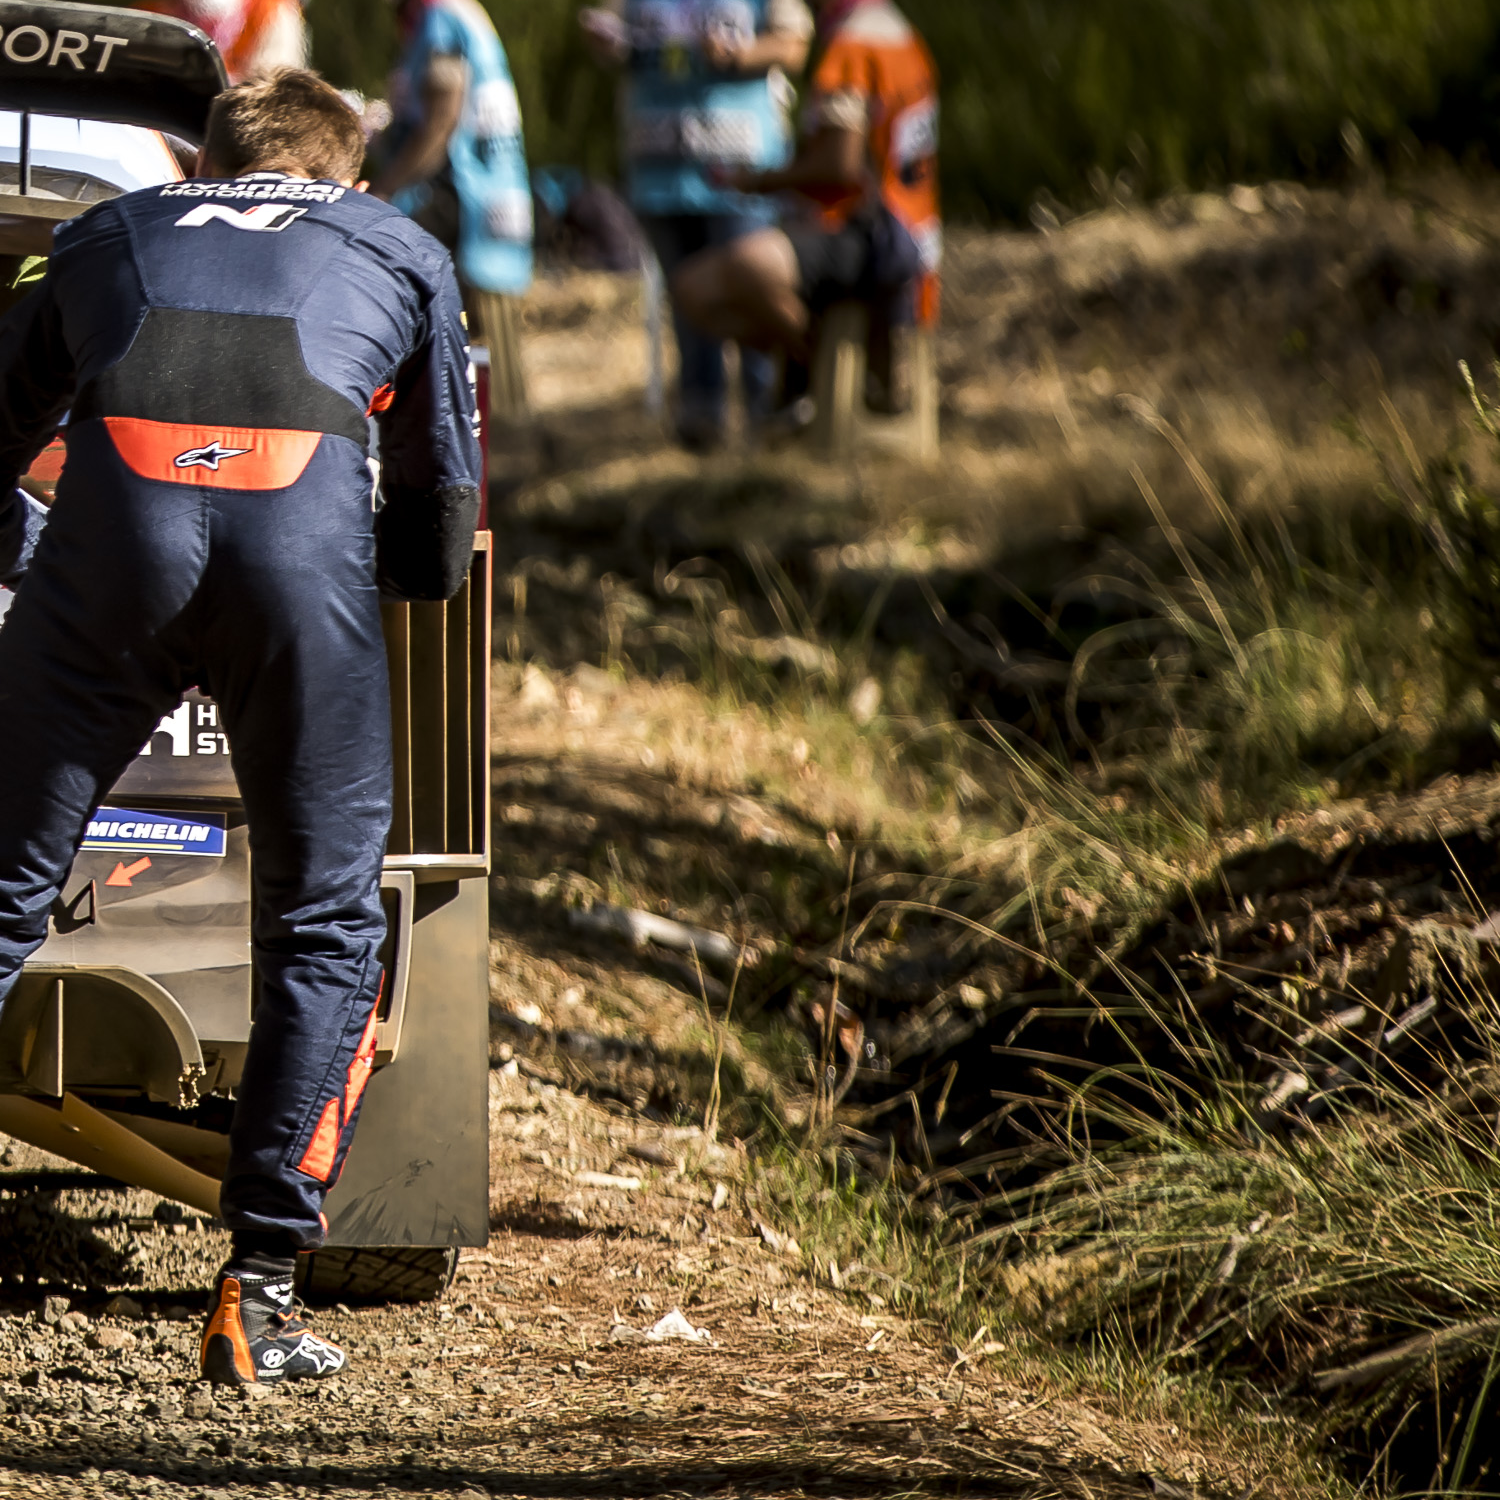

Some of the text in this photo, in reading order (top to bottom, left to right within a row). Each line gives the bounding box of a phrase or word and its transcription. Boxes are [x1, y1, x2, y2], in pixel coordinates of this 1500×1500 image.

[159, 188, 342, 204] MOTORSPORT
[164, 182, 347, 197] HYUNDAI
[85, 820, 211, 842] MICHELIN
